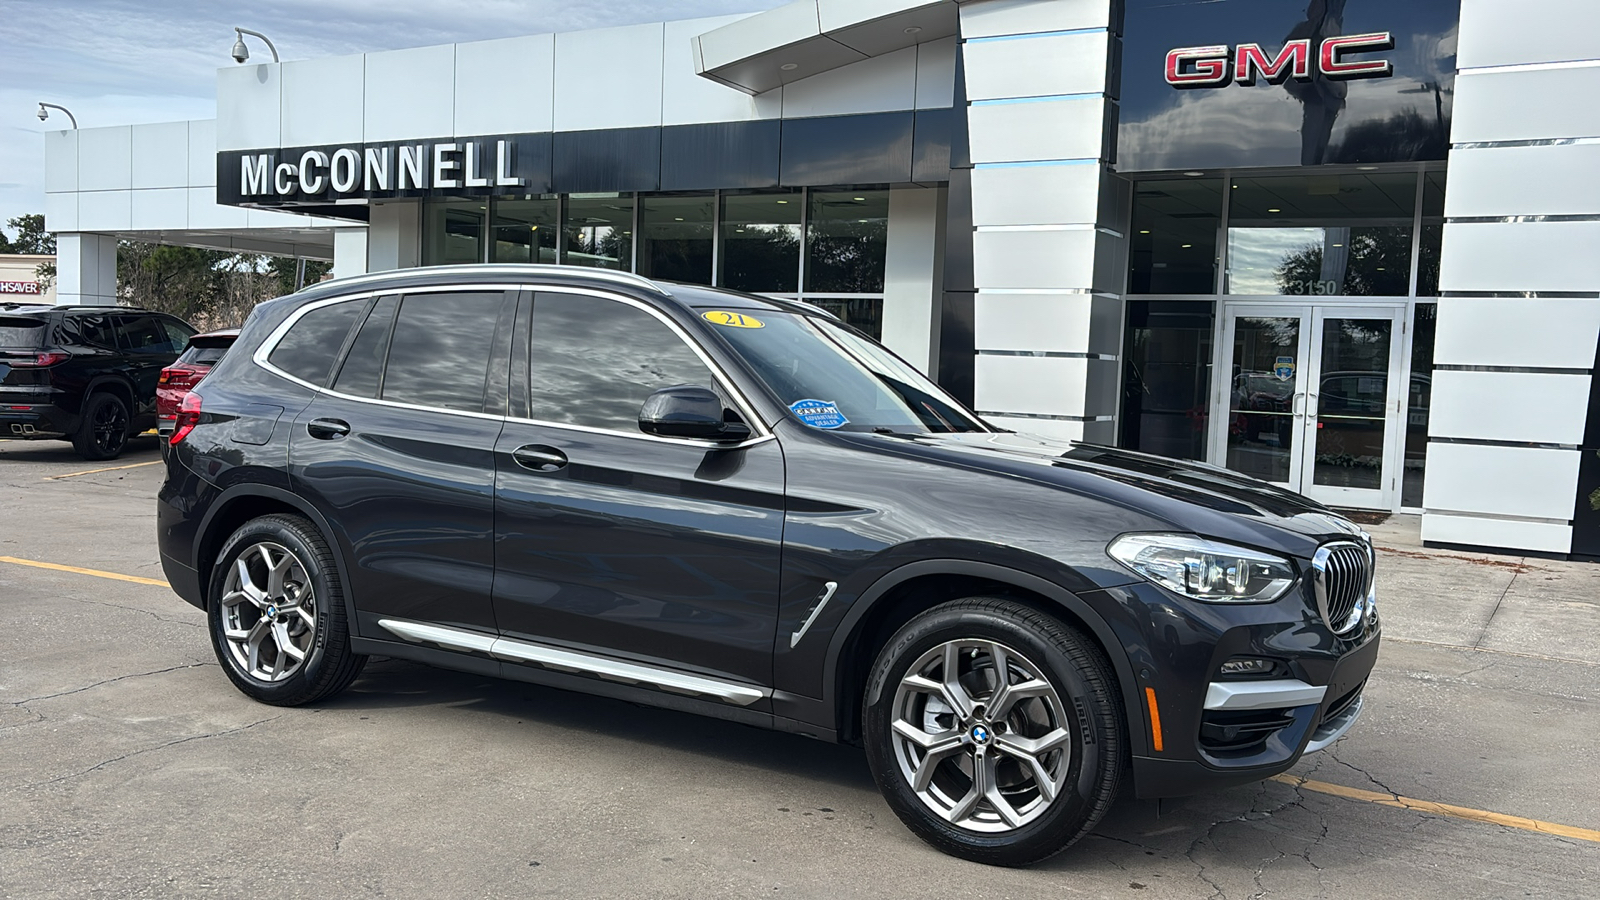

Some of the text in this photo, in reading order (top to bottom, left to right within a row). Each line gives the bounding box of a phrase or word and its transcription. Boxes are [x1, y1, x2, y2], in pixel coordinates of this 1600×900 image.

[1164, 31, 1394, 90] GMC
[241, 140, 523, 196] McCONNELL
[1294, 279, 1337, 295] 3150
[720, 312, 748, 326] 21
[1074, 695, 1097, 745] PIRELLI
